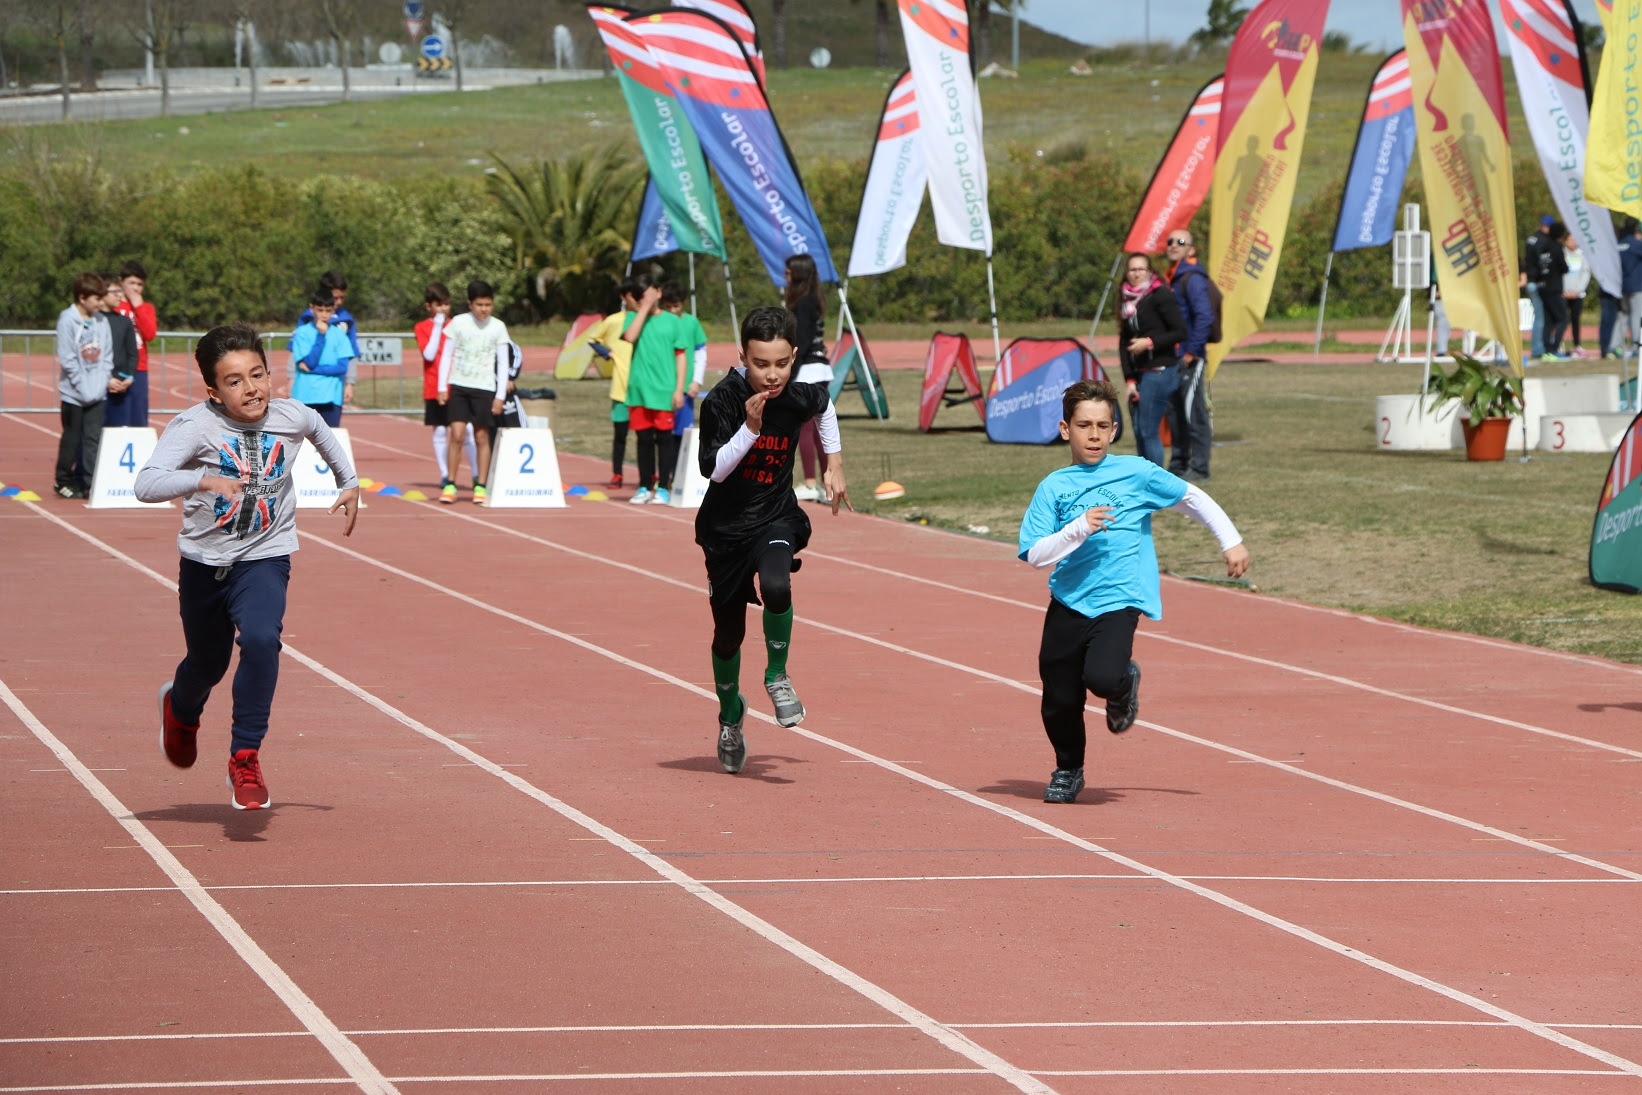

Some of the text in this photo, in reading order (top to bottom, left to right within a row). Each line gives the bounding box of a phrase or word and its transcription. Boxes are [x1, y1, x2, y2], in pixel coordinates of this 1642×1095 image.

[1620, 33, 1642, 203] Desporto
[940, 51, 984, 242] Desporto Escolar
[655, 97, 715, 249] Desporto Escolar
[721, 112, 809, 255] sporto Escolar
[989, 390, 1035, 419] Desporto
[1381, 417, 1392, 446] 2
[1552, 421, 1566, 450] 3
[118, 443, 136, 473] 4
[519, 443, 535, 474] 2
